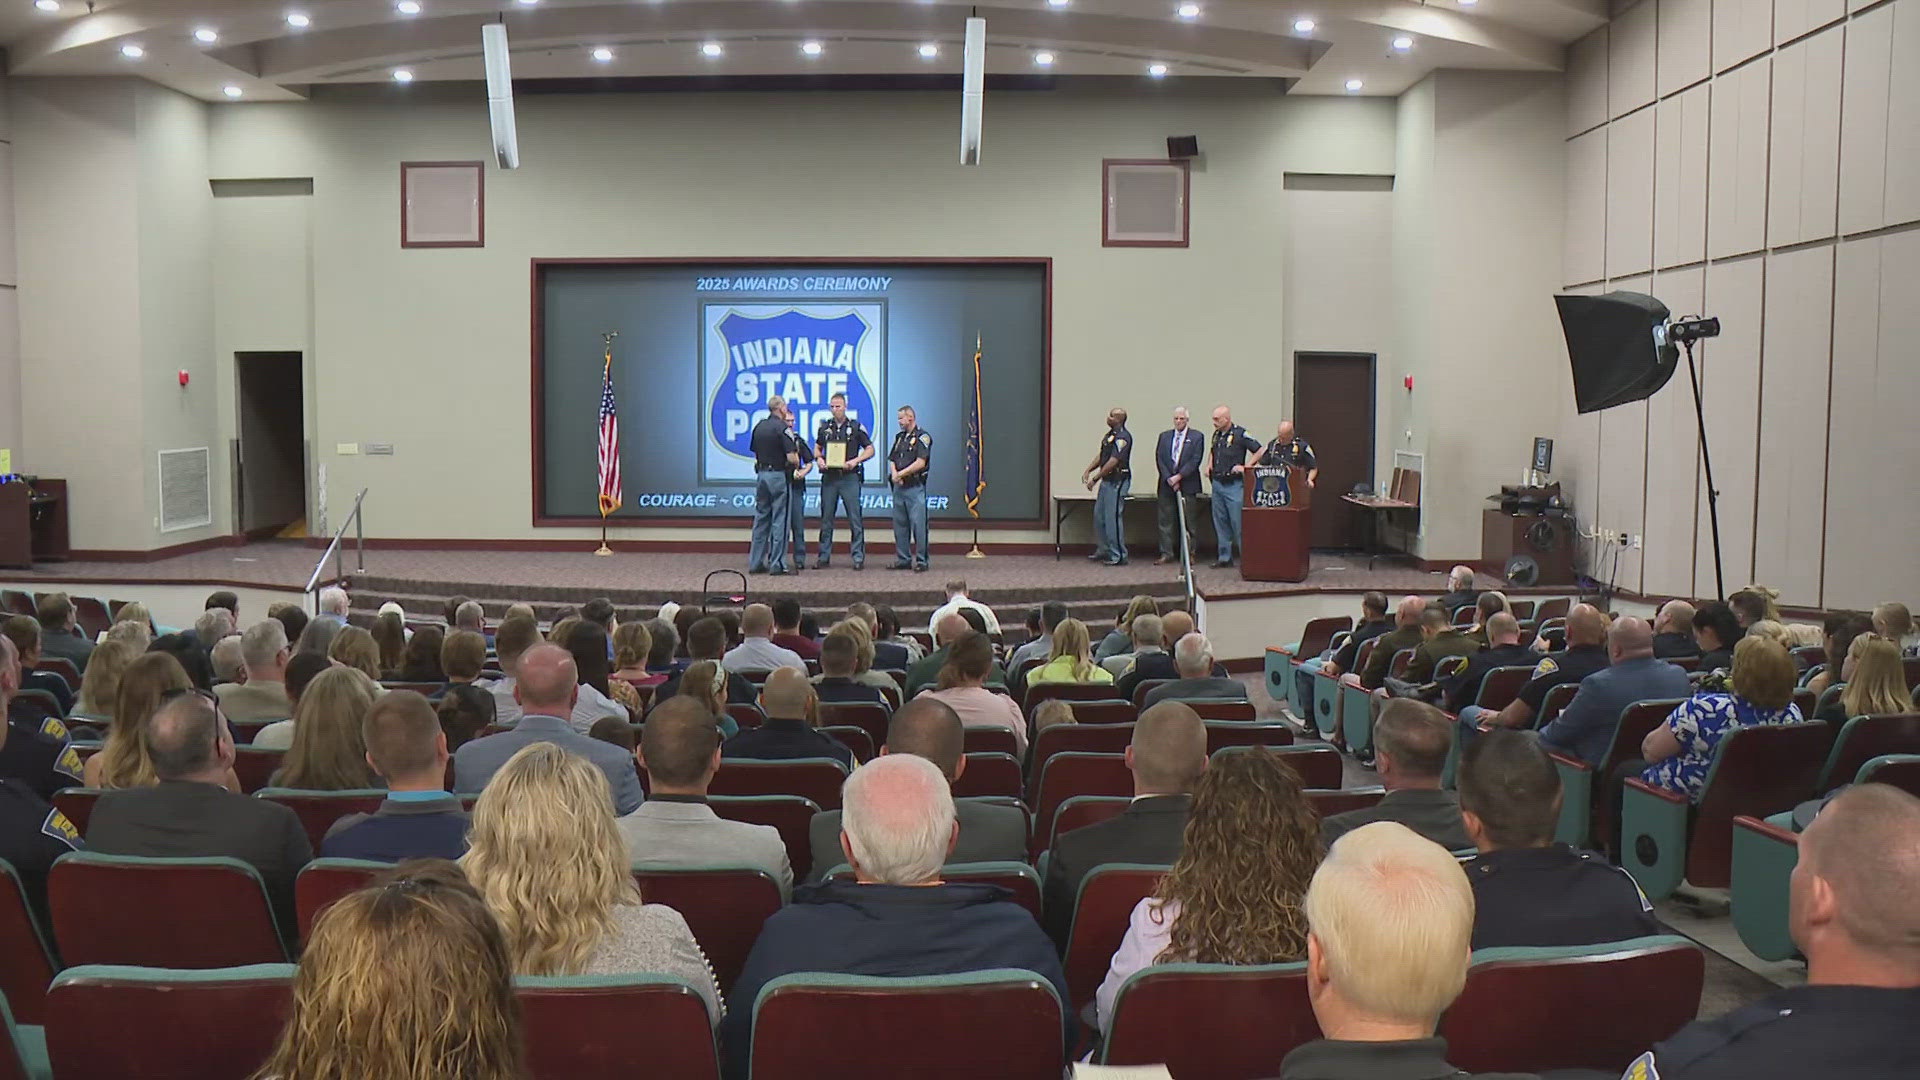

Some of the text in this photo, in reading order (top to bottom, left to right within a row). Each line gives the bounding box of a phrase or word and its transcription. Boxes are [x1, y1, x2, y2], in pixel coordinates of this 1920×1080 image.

[696, 277, 892, 291] 2025 AWARDS CEREMONY
[731, 337, 854, 372] INDIANA
[736, 372, 848, 404] STATE
[639, 494, 717, 507] COURAGE
